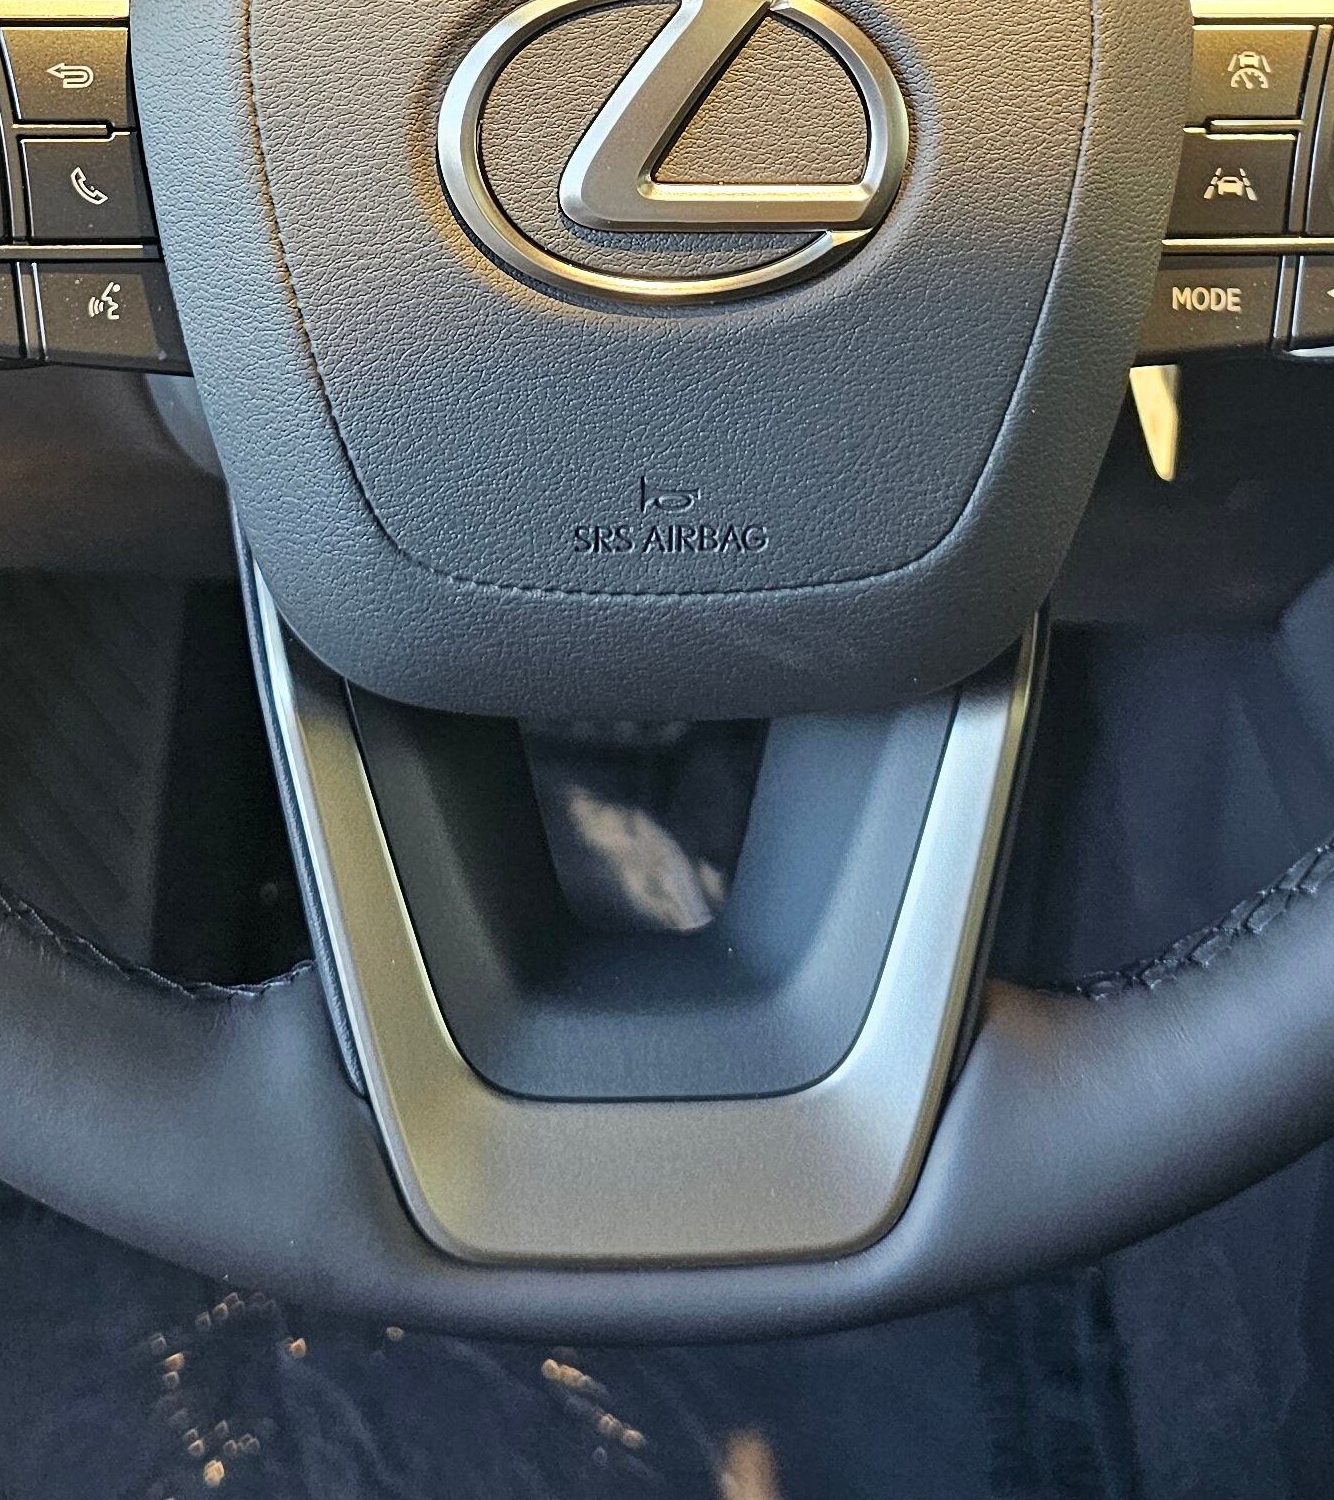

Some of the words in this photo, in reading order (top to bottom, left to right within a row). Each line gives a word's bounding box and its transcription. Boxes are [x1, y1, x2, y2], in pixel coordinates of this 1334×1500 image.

[1171, 286, 1243, 312] MODE
[573, 524, 636, 555] SRS
[643, 523, 770, 555] AIRBAG
